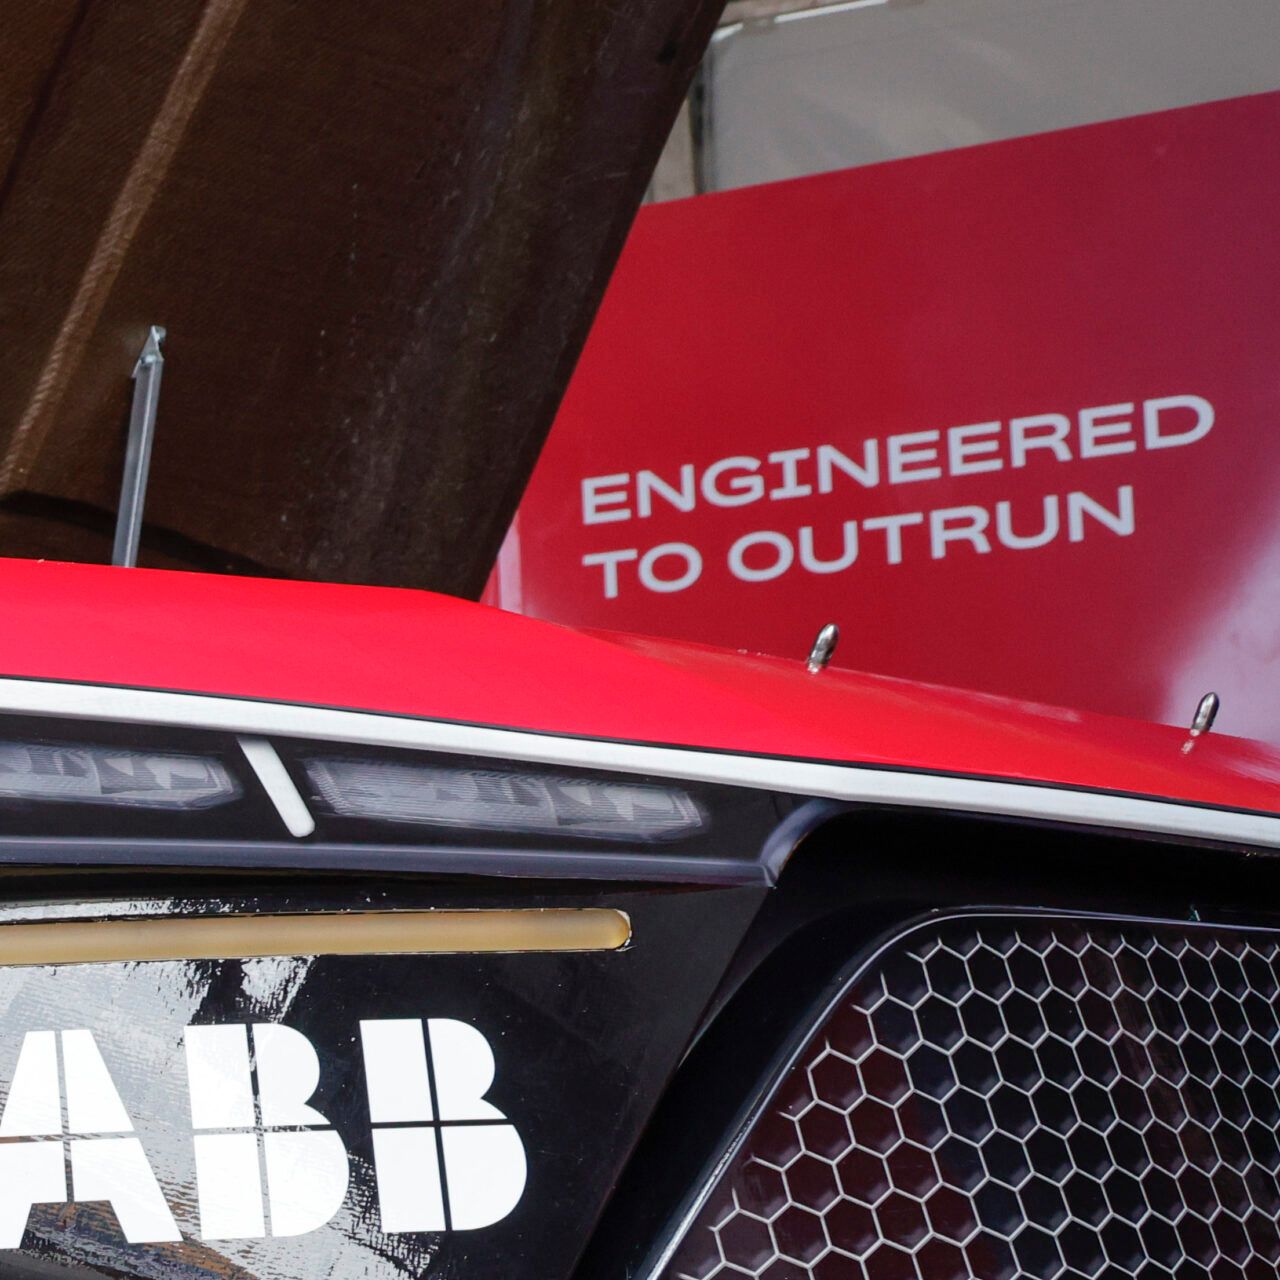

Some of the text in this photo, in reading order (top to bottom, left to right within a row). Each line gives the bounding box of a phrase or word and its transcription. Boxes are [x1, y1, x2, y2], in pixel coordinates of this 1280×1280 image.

[580, 394, 1216, 526] ENGINEERED
[581, 485, 1137, 600] TO OUTRUN
